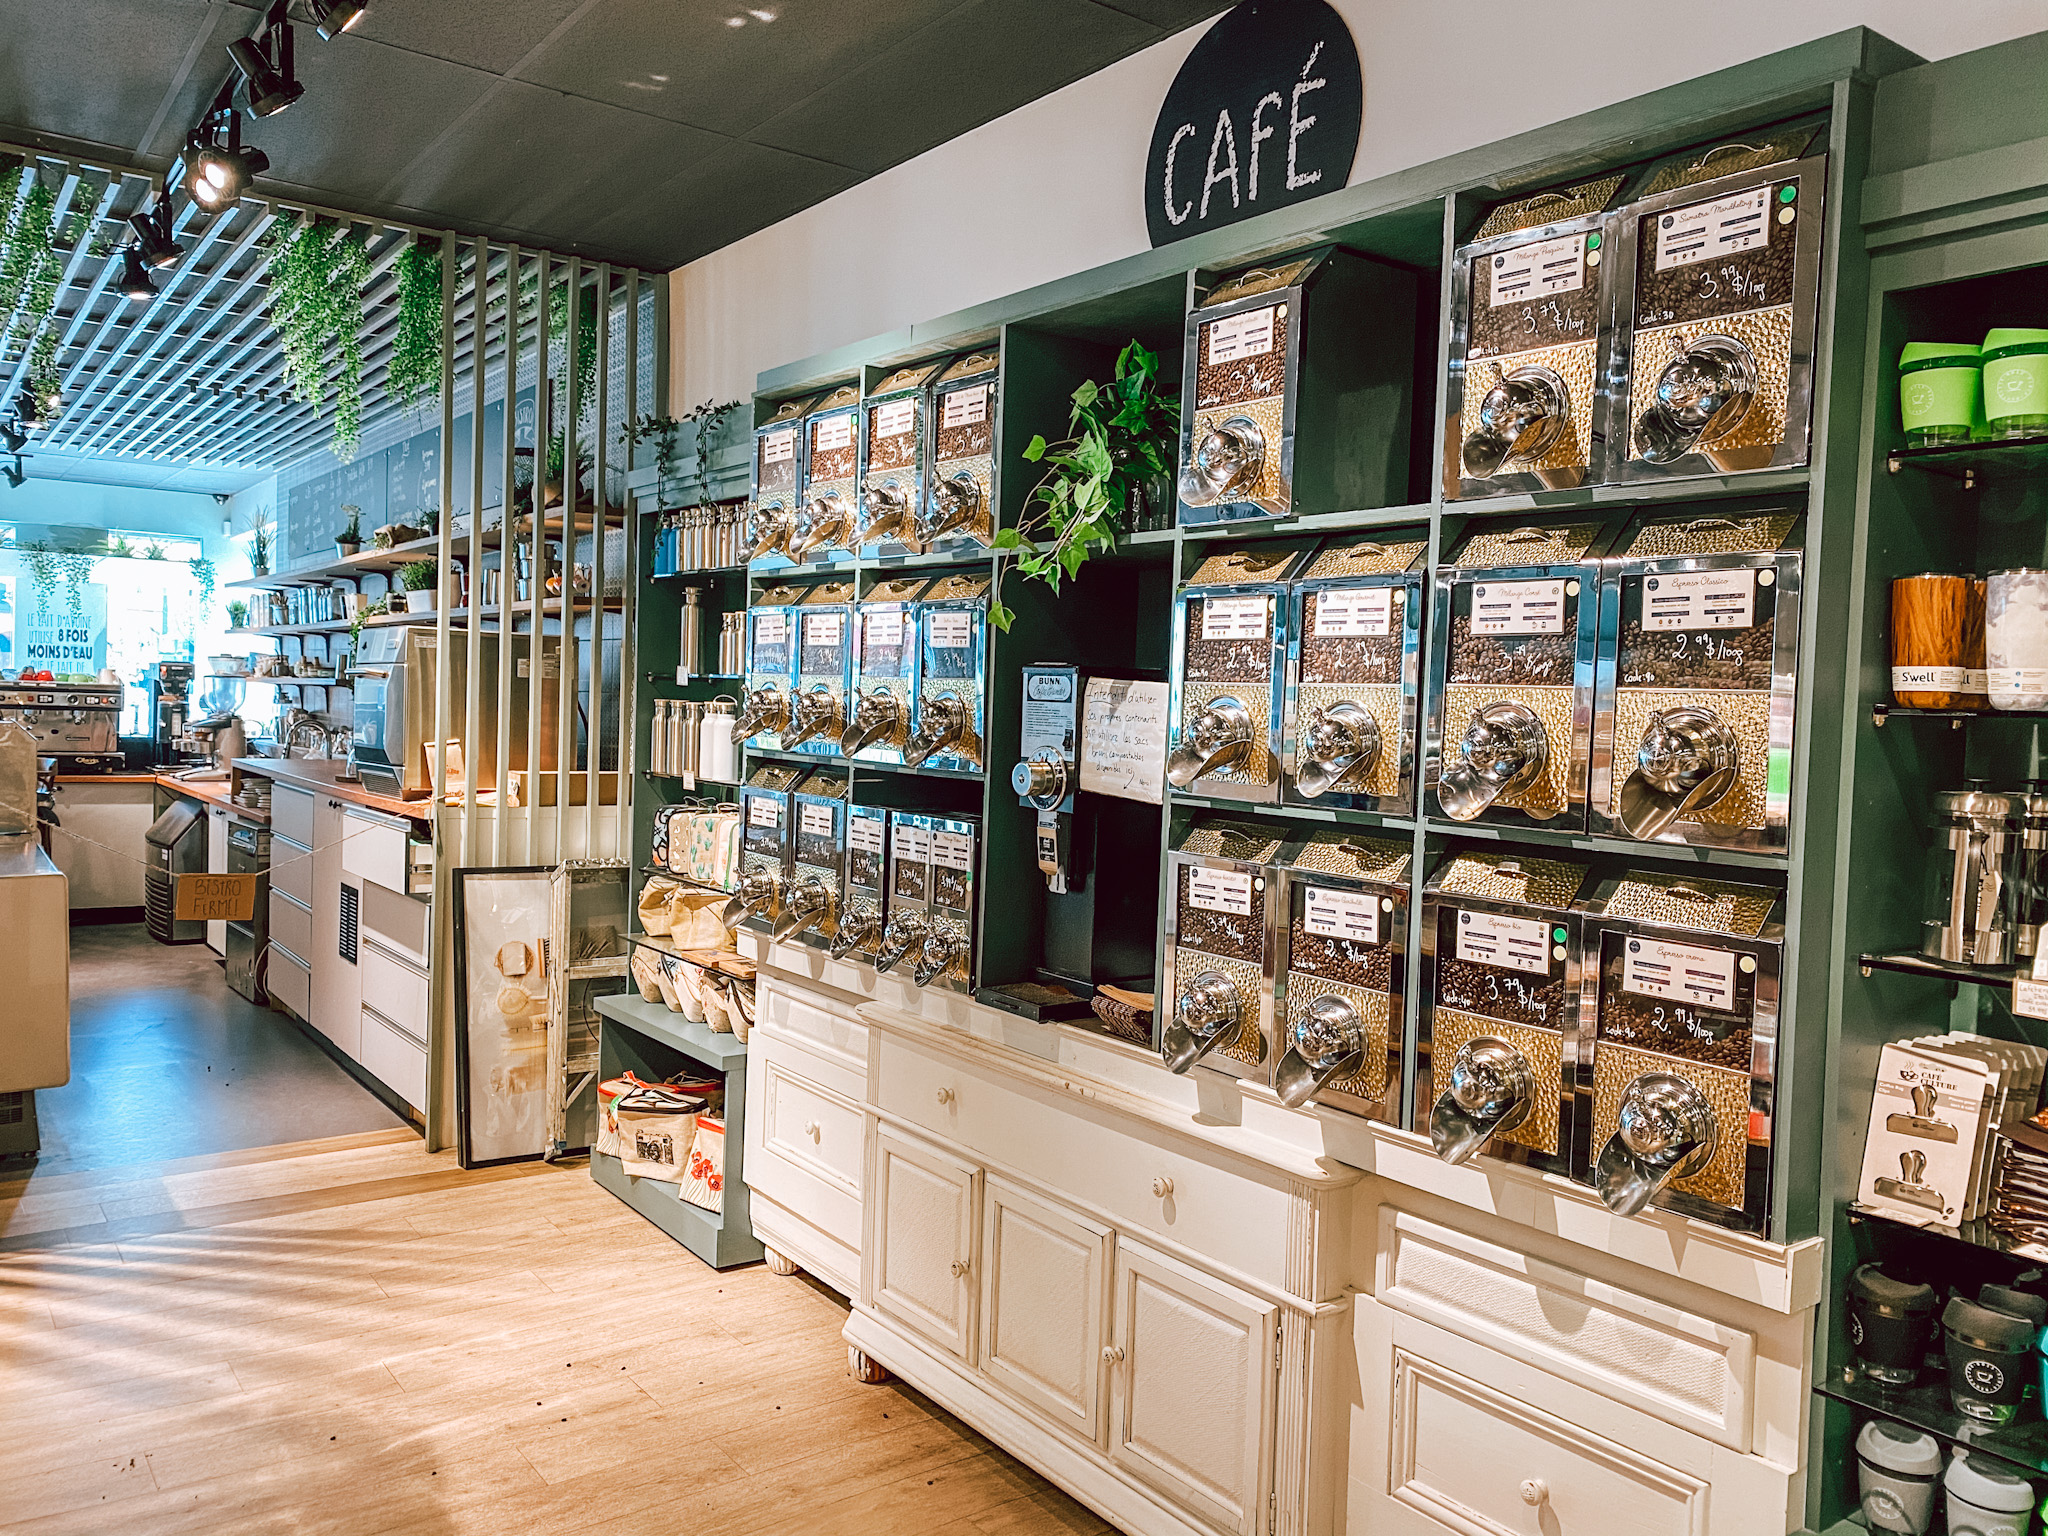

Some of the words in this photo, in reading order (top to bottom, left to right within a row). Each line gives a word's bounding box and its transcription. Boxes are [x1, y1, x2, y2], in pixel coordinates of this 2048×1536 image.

[1164, 41, 1326, 225] CAFÉ
[58, 629, 64, 642] 8
[66, 629, 89, 643] FOIS
[27, 644, 60, 659] MOINS
[63, 645, 93, 660] D'EAU
[1038, 677, 1060, 685] BUNN
[1902, 671, 1935, 683] S'well
[1086, 682, 1125, 701] Interdit
[1134, 736, 1149, 746] sacs
[194, 878, 242, 896] BISTRO
[1921, 1071, 1943, 1082] CAFÉ
[1920, 1078, 1958, 1091] CULTURE
